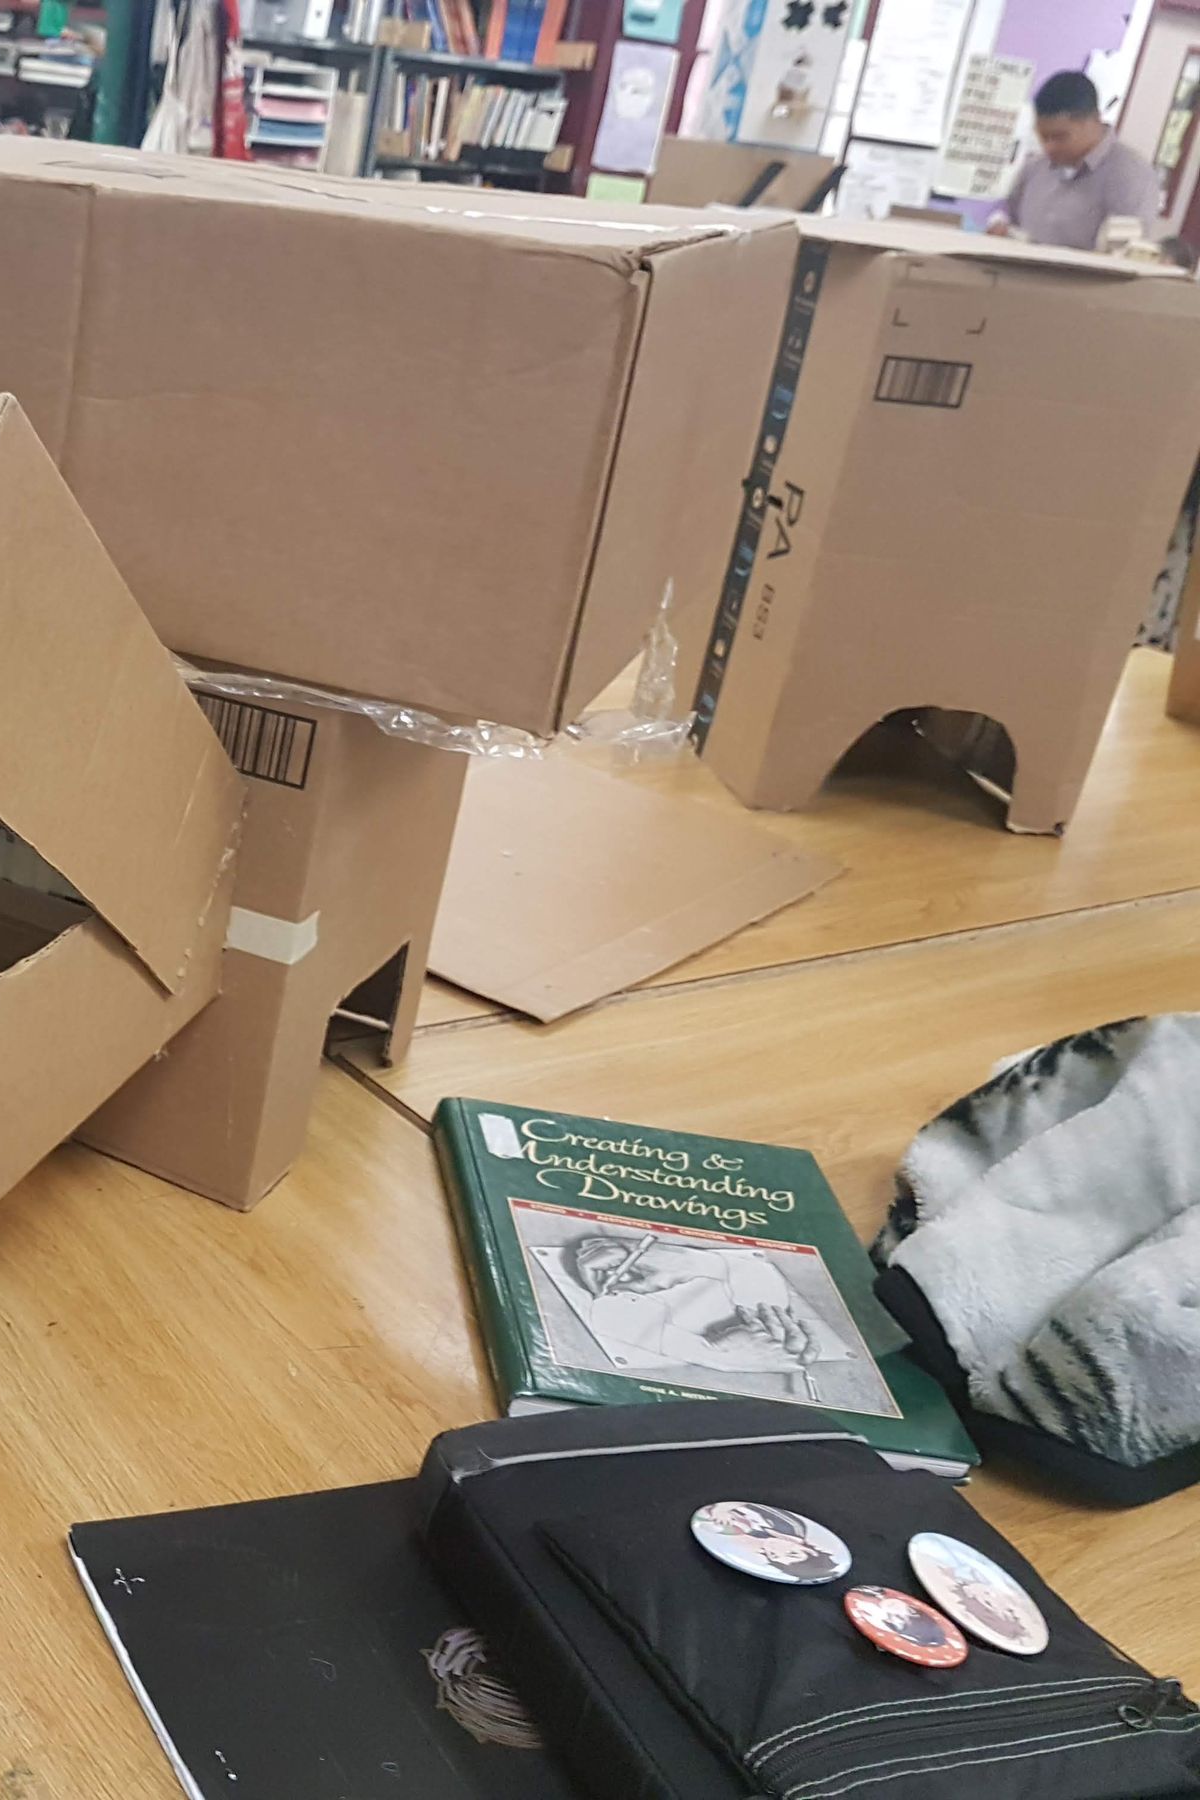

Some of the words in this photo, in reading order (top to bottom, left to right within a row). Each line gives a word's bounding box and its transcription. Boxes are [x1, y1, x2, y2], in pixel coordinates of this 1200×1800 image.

[518, 1139, 796, 1213] Understanding
[520, 1119, 690, 1171] Creating
[702, 1153, 745, 1172] &
[536, 1168, 770, 1231] Drawings
